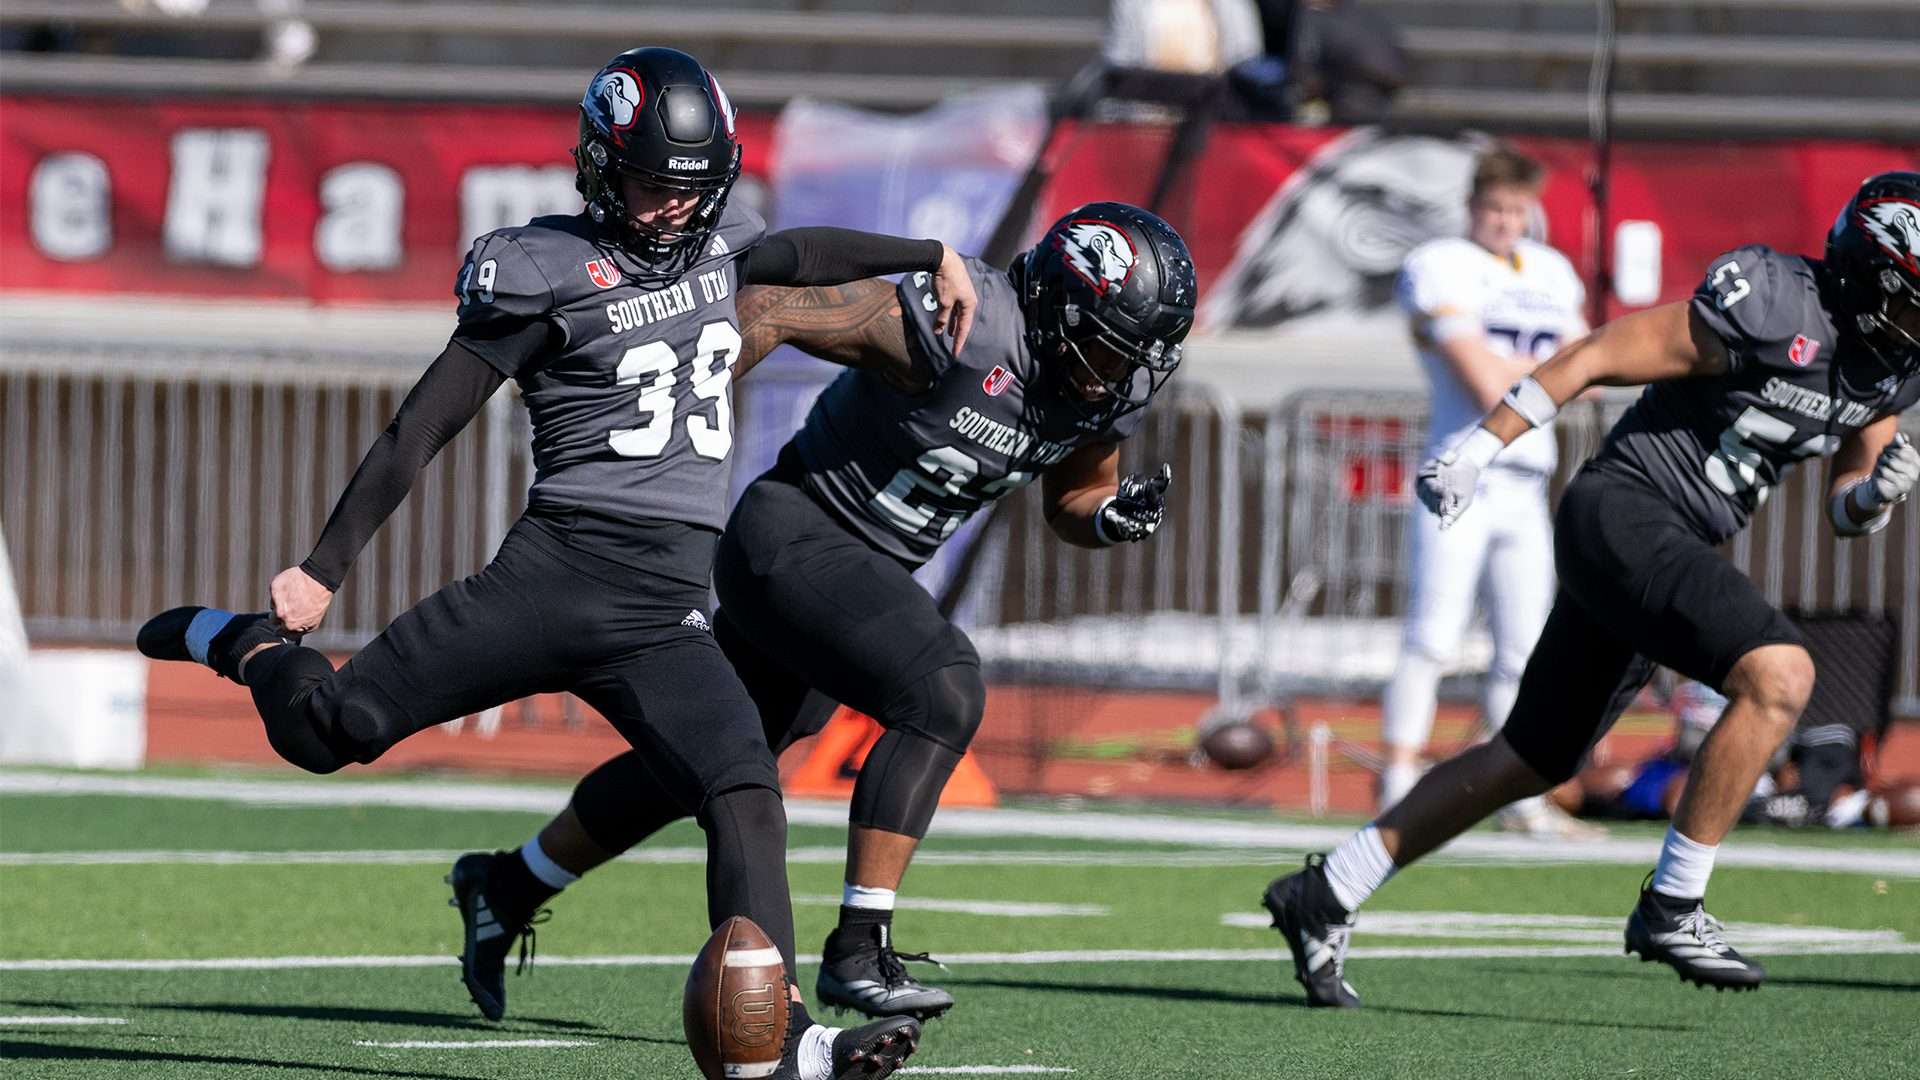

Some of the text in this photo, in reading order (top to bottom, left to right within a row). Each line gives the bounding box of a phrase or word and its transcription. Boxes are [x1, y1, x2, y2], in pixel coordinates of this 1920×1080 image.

[668, 159, 709, 170] Riddell
[606, 280, 696, 334] SOUTHERN
[607, 320, 743, 461] 39
